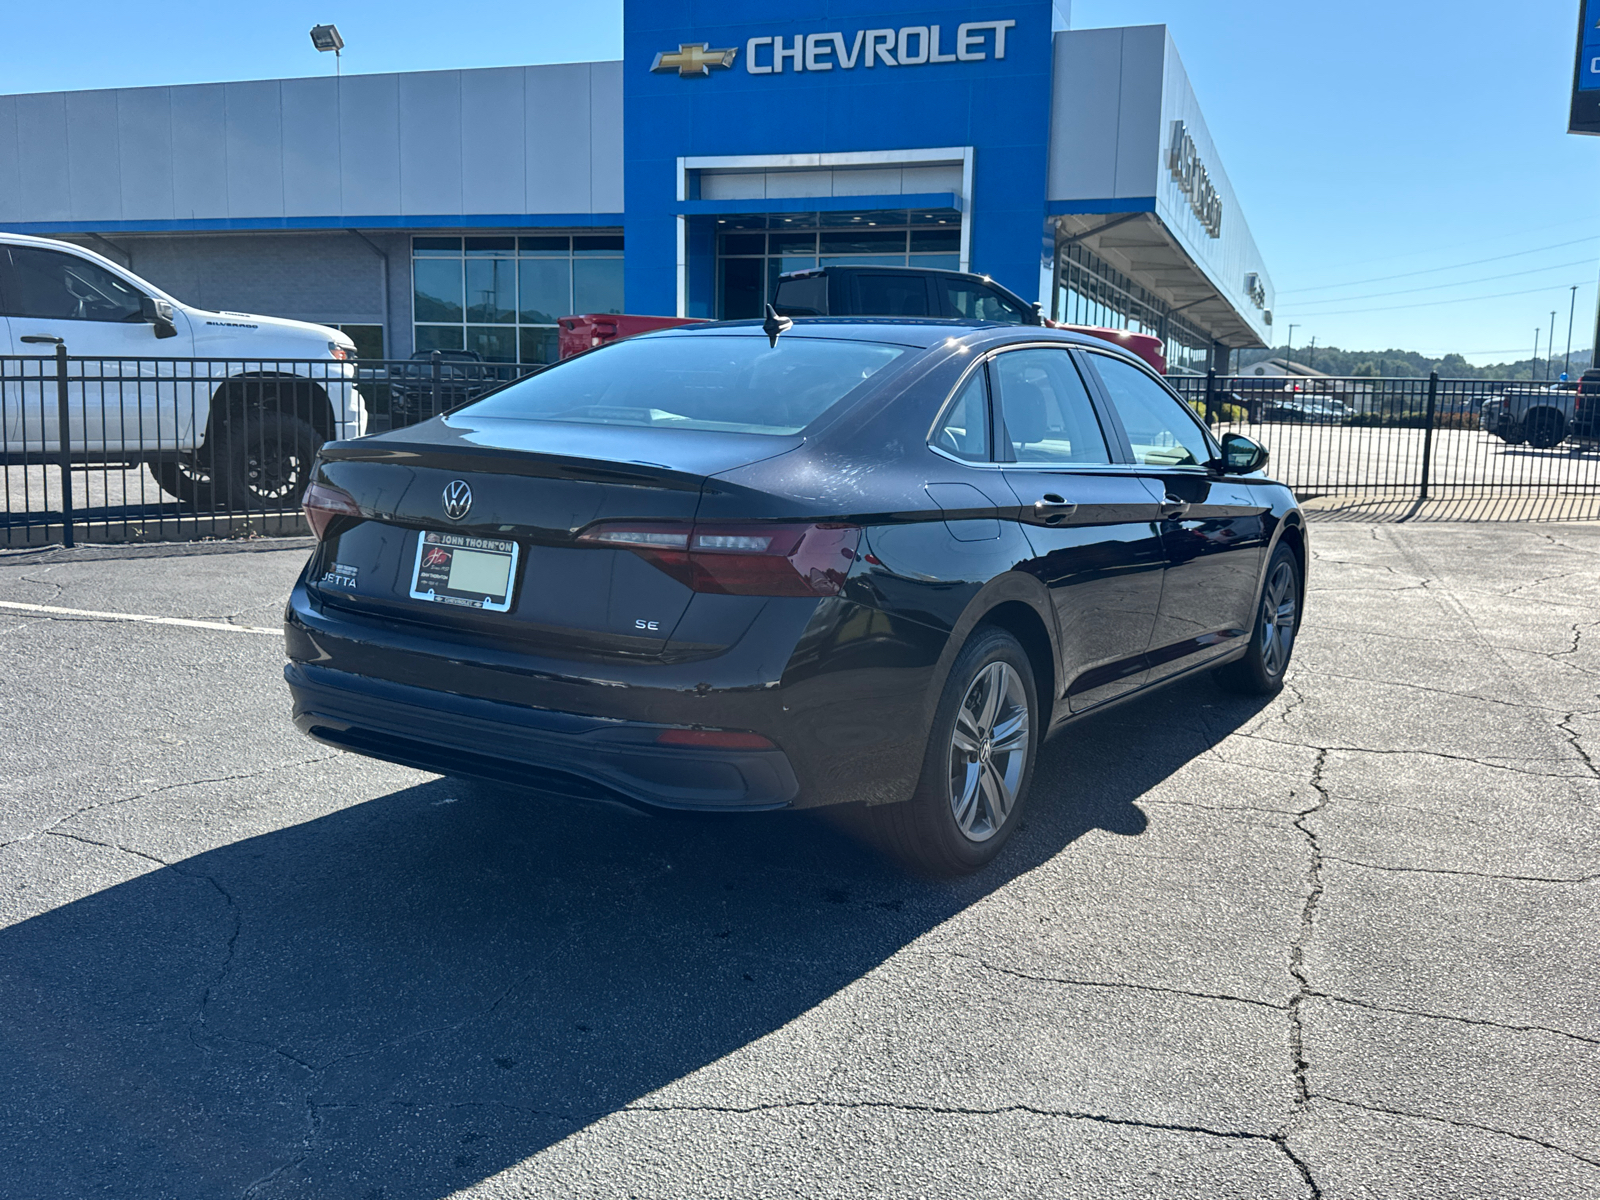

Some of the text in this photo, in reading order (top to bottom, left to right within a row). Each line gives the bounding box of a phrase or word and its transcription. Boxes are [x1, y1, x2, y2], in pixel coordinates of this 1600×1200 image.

[746, 19, 1016, 75] CHEVROLET
[206, 321, 258, 329] SILVERADO
[441, 535, 464, 546] JOHN
[321, 572, 356, 588] JETTA
[635, 619, 659, 630] SE
